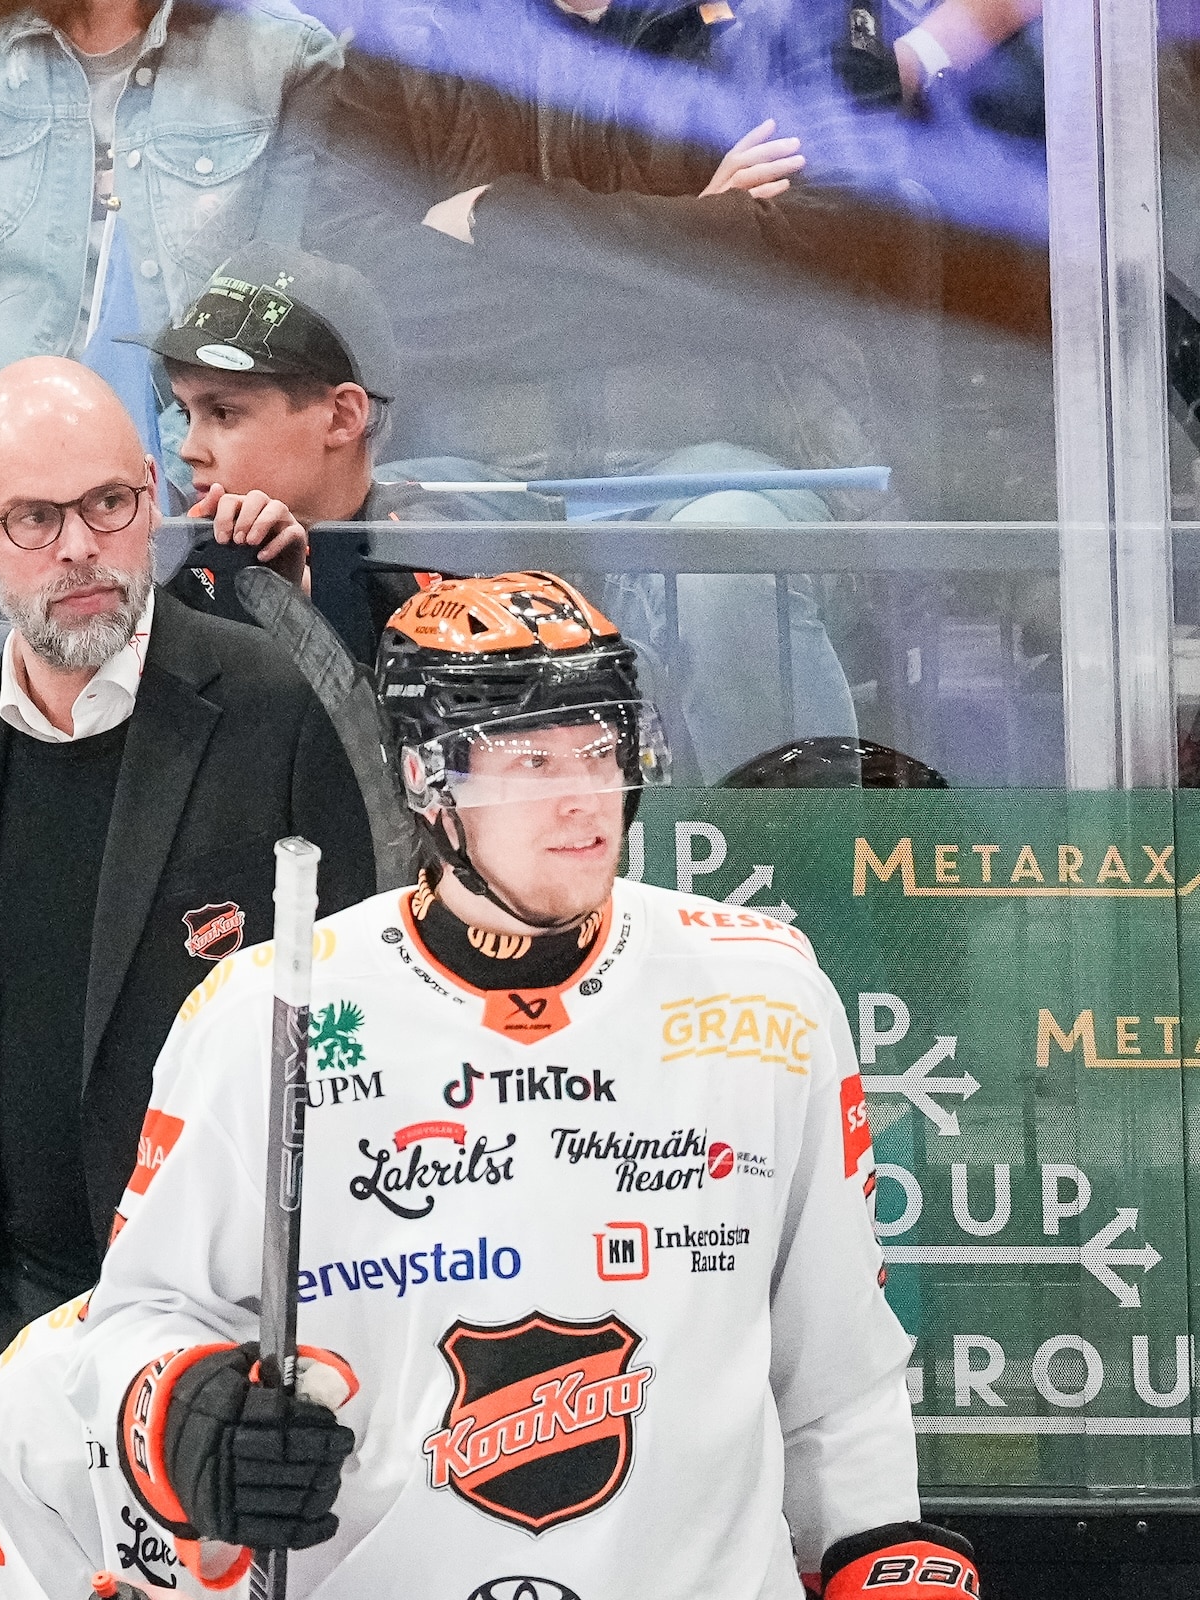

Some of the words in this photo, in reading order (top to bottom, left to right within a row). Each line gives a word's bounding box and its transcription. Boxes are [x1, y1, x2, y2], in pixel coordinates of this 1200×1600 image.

[1035, 1008, 1200, 1069] MET
[305, 1069, 387, 1109] UPM
[490, 1065, 618, 1104] TikTok
[736, 1151, 768, 1166] REAK
[690, 1250, 736, 1274] Rauta
[424, 1365, 657, 1490] KooKoo
